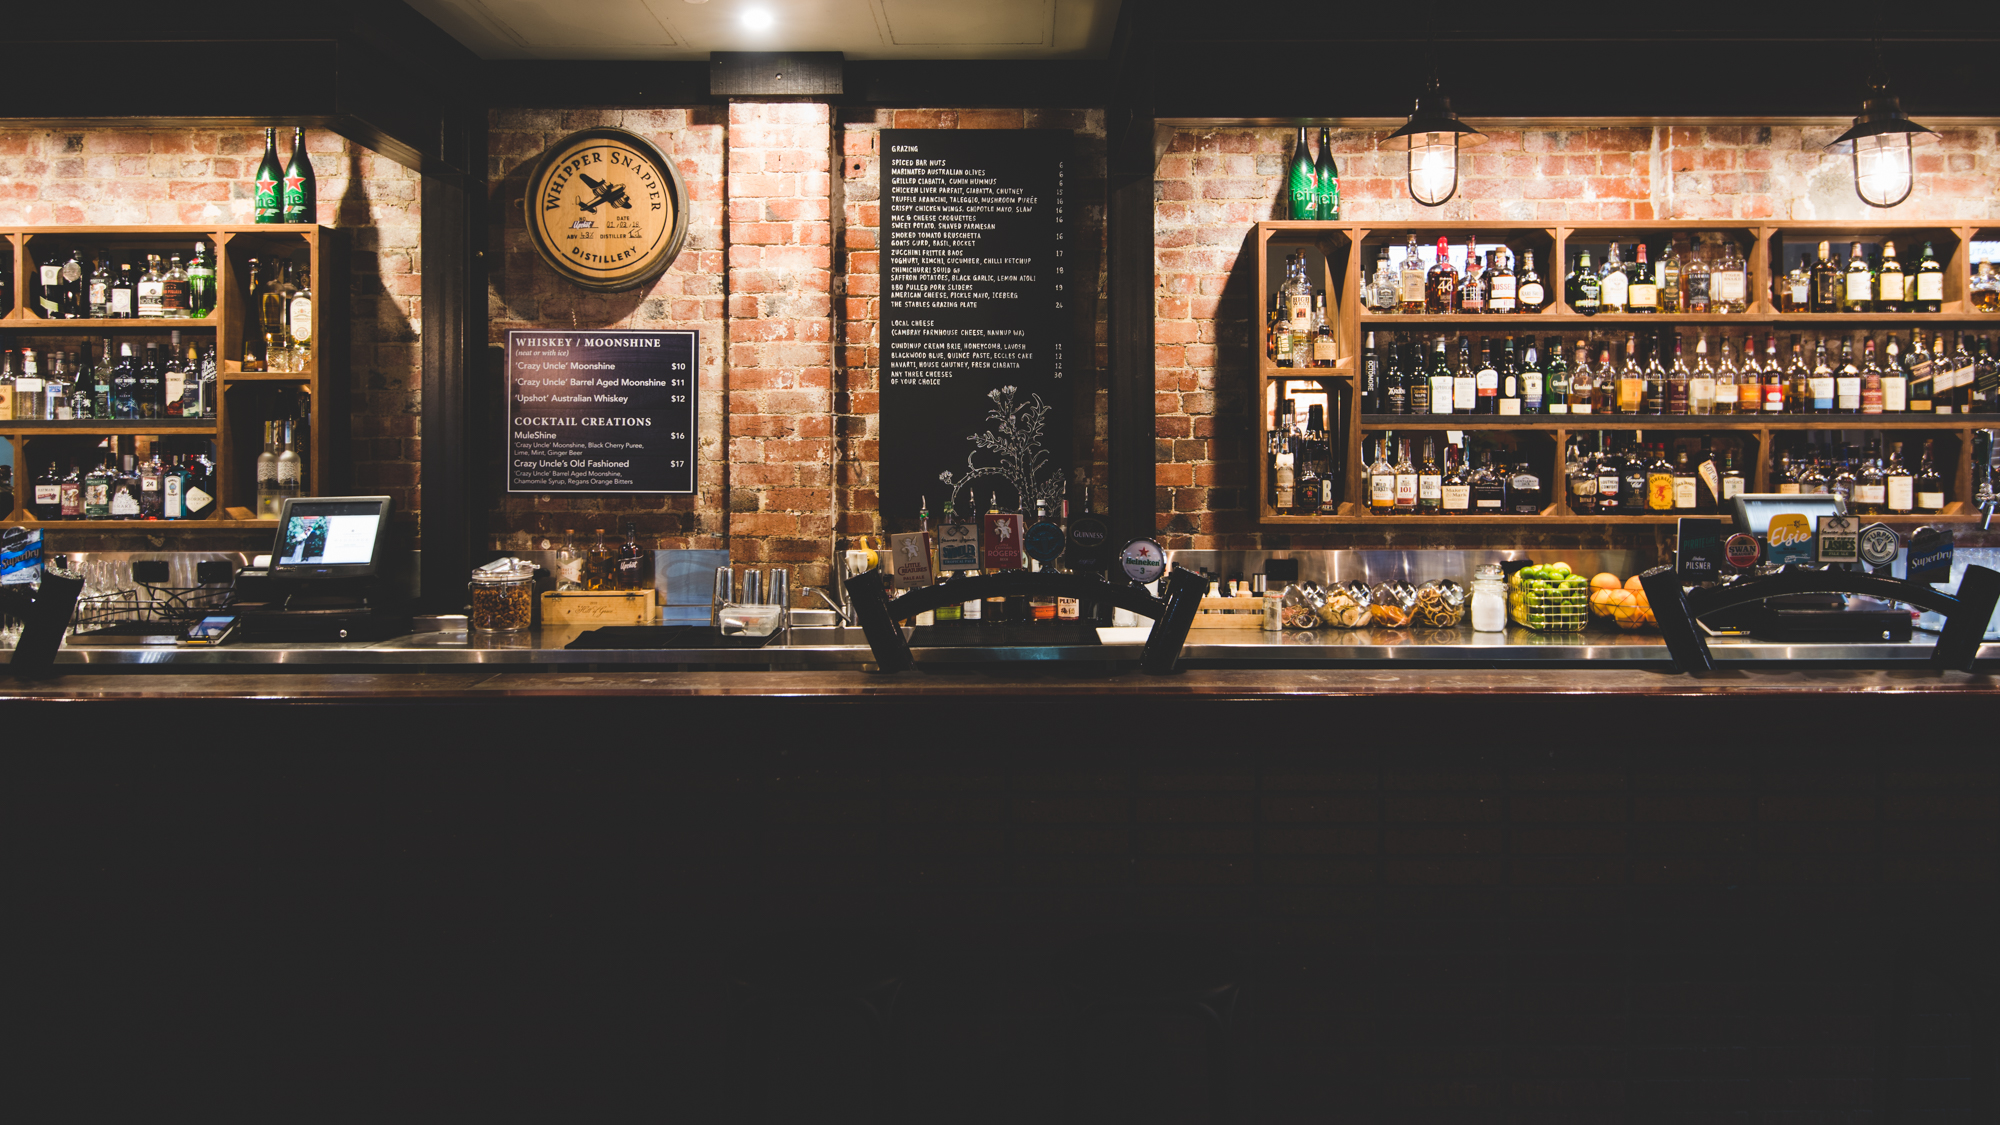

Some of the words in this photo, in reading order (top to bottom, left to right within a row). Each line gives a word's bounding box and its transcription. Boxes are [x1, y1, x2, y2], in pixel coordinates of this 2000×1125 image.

[546, 152, 602, 212] WHIPPER
[610, 152, 661, 212] SNAPPER
[572, 246, 637, 264] DISTILLERY
[516, 338, 572, 346] WHISKEY
[584, 338, 660, 348] MOONSHINE
[557, 349, 569, 358] ice)
[570, 362, 616, 370] Moonshine
[570, 378, 594, 386] Barrel
[596, 378, 619, 388] Aged
[621, 378, 666, 387] Moonshine
[671, 378, 684, 387] $11
[551, 394, 592, 402] Australian
[594, 394, 628, 404] Whiskey
[514, 417, 578, 426] COCKTAIL
[581, 417, 651, 426] CREATIONS
[514, 431, 557, 439] MuleShine
[514, 459, 537, 469] Crazy
[539, 459, 568, 468] Uncle's
[570, 459, 586, 468] Old
[588, 459, 630, 468] Fashioned
[1073, 530, 1104, 539] GUINNESS
[1770, 527, 1809, 547] Elsie
[1867, 531, 1894, 543] FURPHY
[1822, 541, 1855, 550] LASHES
[2, 549, 39, 570] SuperDry
[1126, 557, 1160, 566] Heineken
[1911, 551, 1952, 569] SuperDry
[1685, 562, 1711, 570] PILSNER
